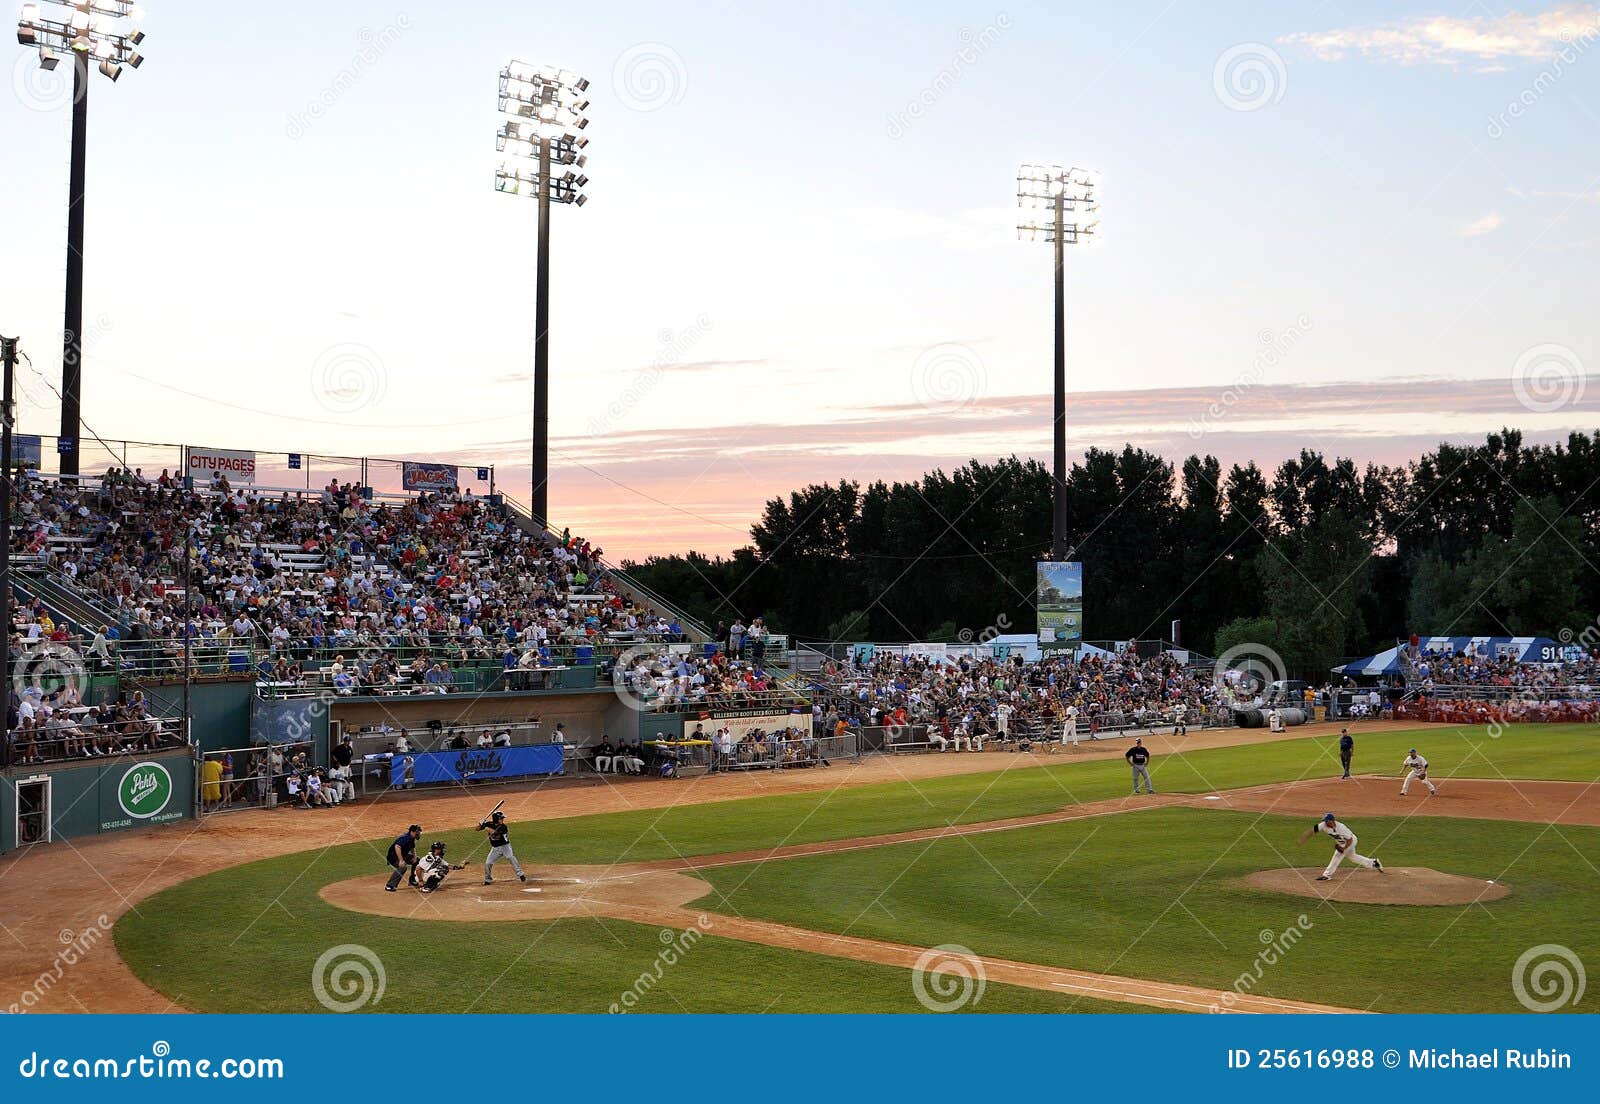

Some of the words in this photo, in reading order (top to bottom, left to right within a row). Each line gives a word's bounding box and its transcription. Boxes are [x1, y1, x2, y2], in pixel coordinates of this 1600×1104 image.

[190, 455, 217, 469] CITY
[218, 457, 255, 472] PAGES
[455, 751, 503, 773] Saints
